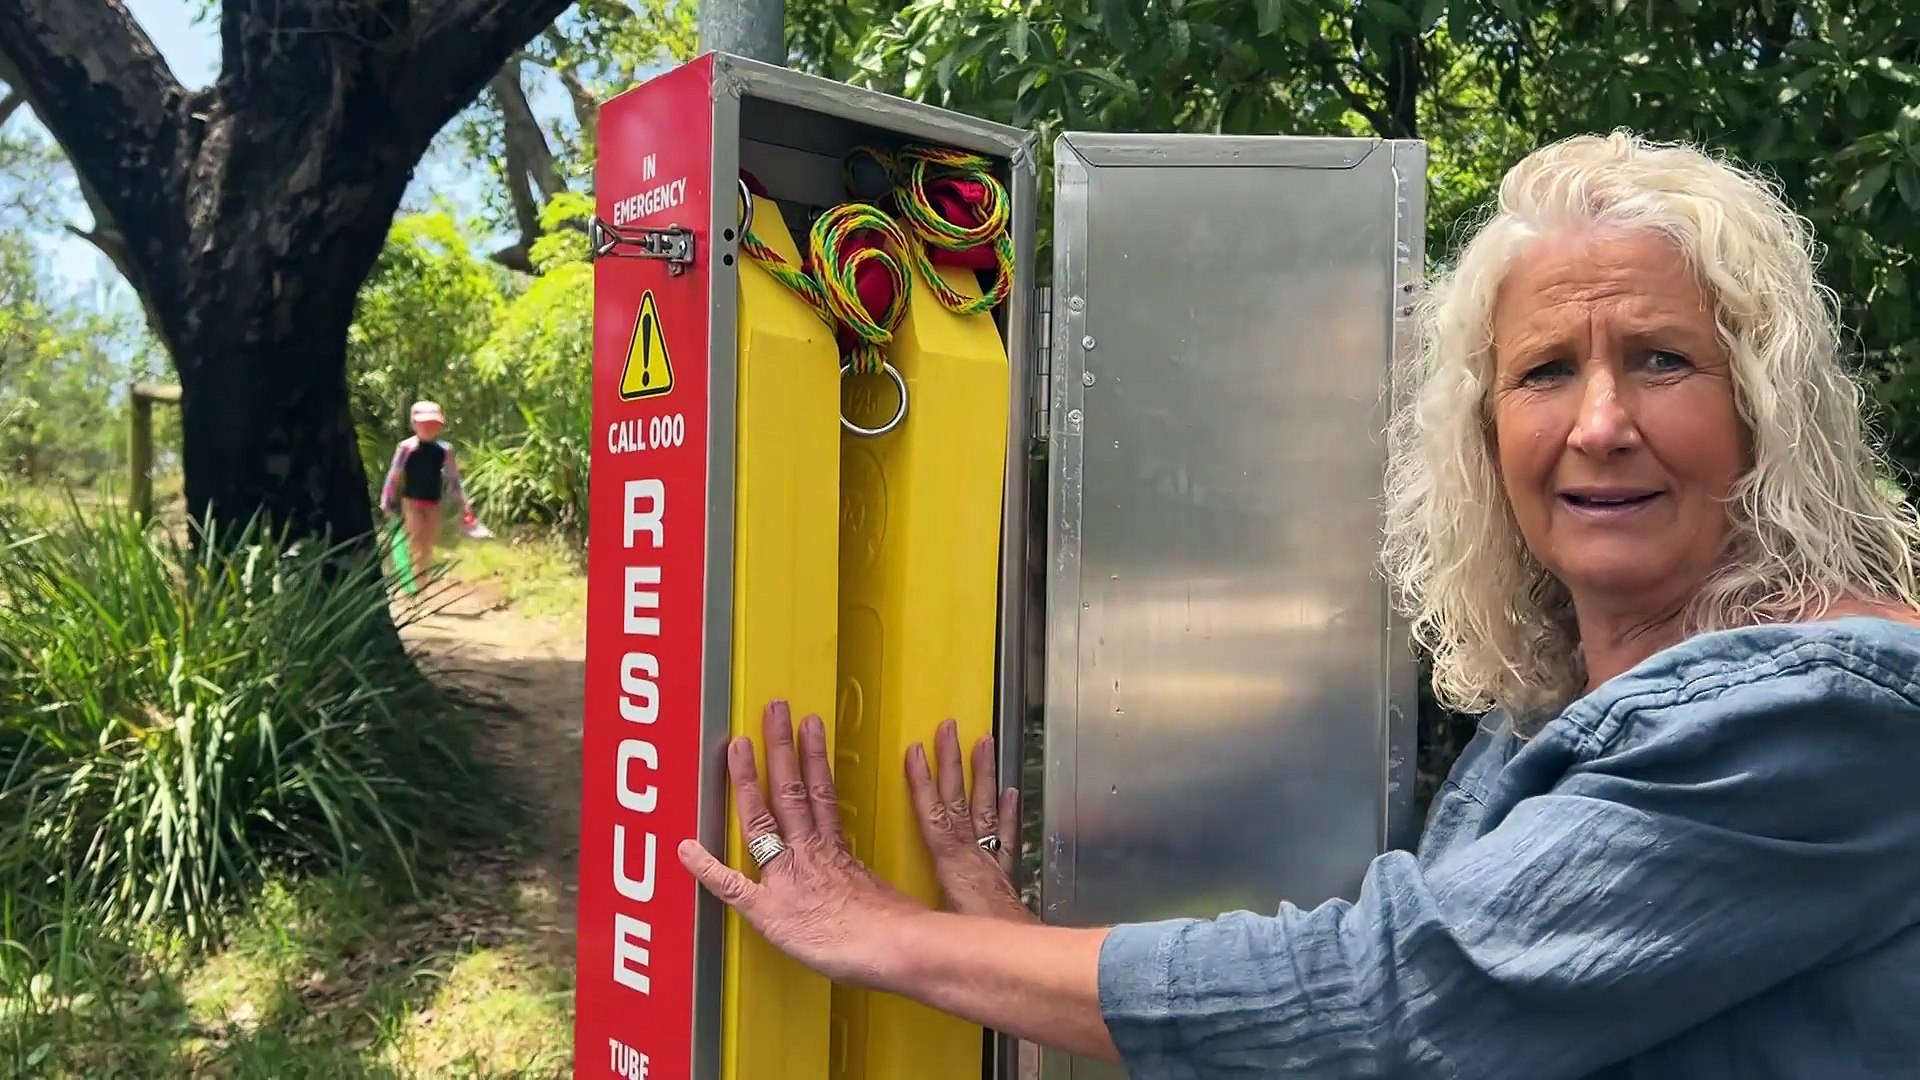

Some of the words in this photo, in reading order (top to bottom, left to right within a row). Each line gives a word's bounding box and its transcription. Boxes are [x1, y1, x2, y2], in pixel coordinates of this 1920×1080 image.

[642, 153, 656, 182] IN
[613, 177, 687, 226] EMERGENCY
[608, 418, 646, 454] CALL
[649, 413, 685, 450] 000
[612, 478, 665, 995] RESCUE
